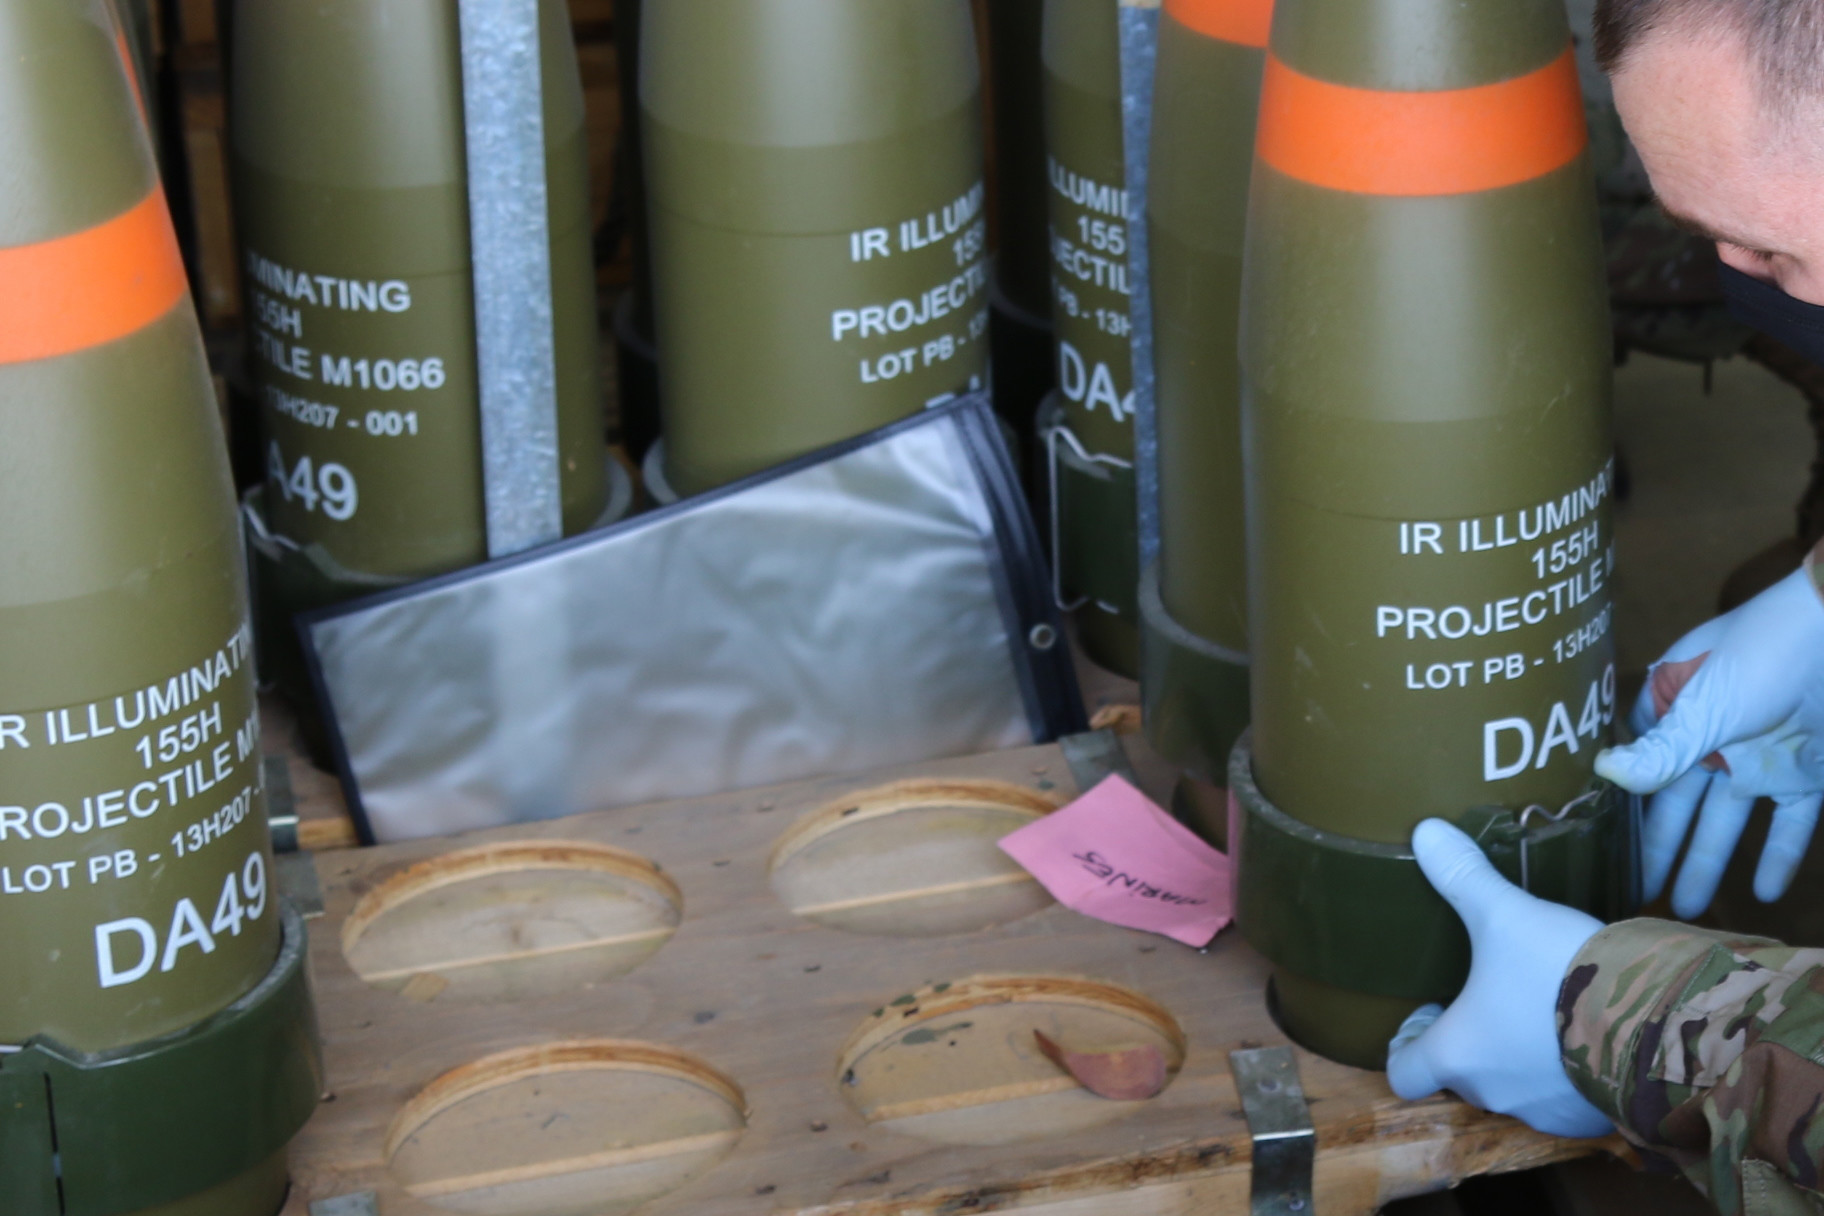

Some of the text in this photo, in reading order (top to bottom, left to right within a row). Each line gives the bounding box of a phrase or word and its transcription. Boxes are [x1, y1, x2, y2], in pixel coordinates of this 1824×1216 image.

[850, 227, 889, 262] IR
[321, 354, 446, 391] M1066
[860, 348, 917, 384] LOT
[923, 334, 955, 367] PB
[365, 409, 419, 437] 001
[1400, 522, 1444, 555] IR
[1532, 520, 1600, 579] 155H
[1376, 558, 1603, 641] PROJECTILE
[1406, 662, 1474, 689] LOT
[1484, 653, 1526, 684] PB
[135, 701, 223, 770] 155H
[1484, 662, 1616, 782] DA49
[3, 860, 76, 894] LOT
[89, 849, 138, 884] PB
[171, 786, 251, 860] 13H207
[95, 851, 268, 989] DA49
